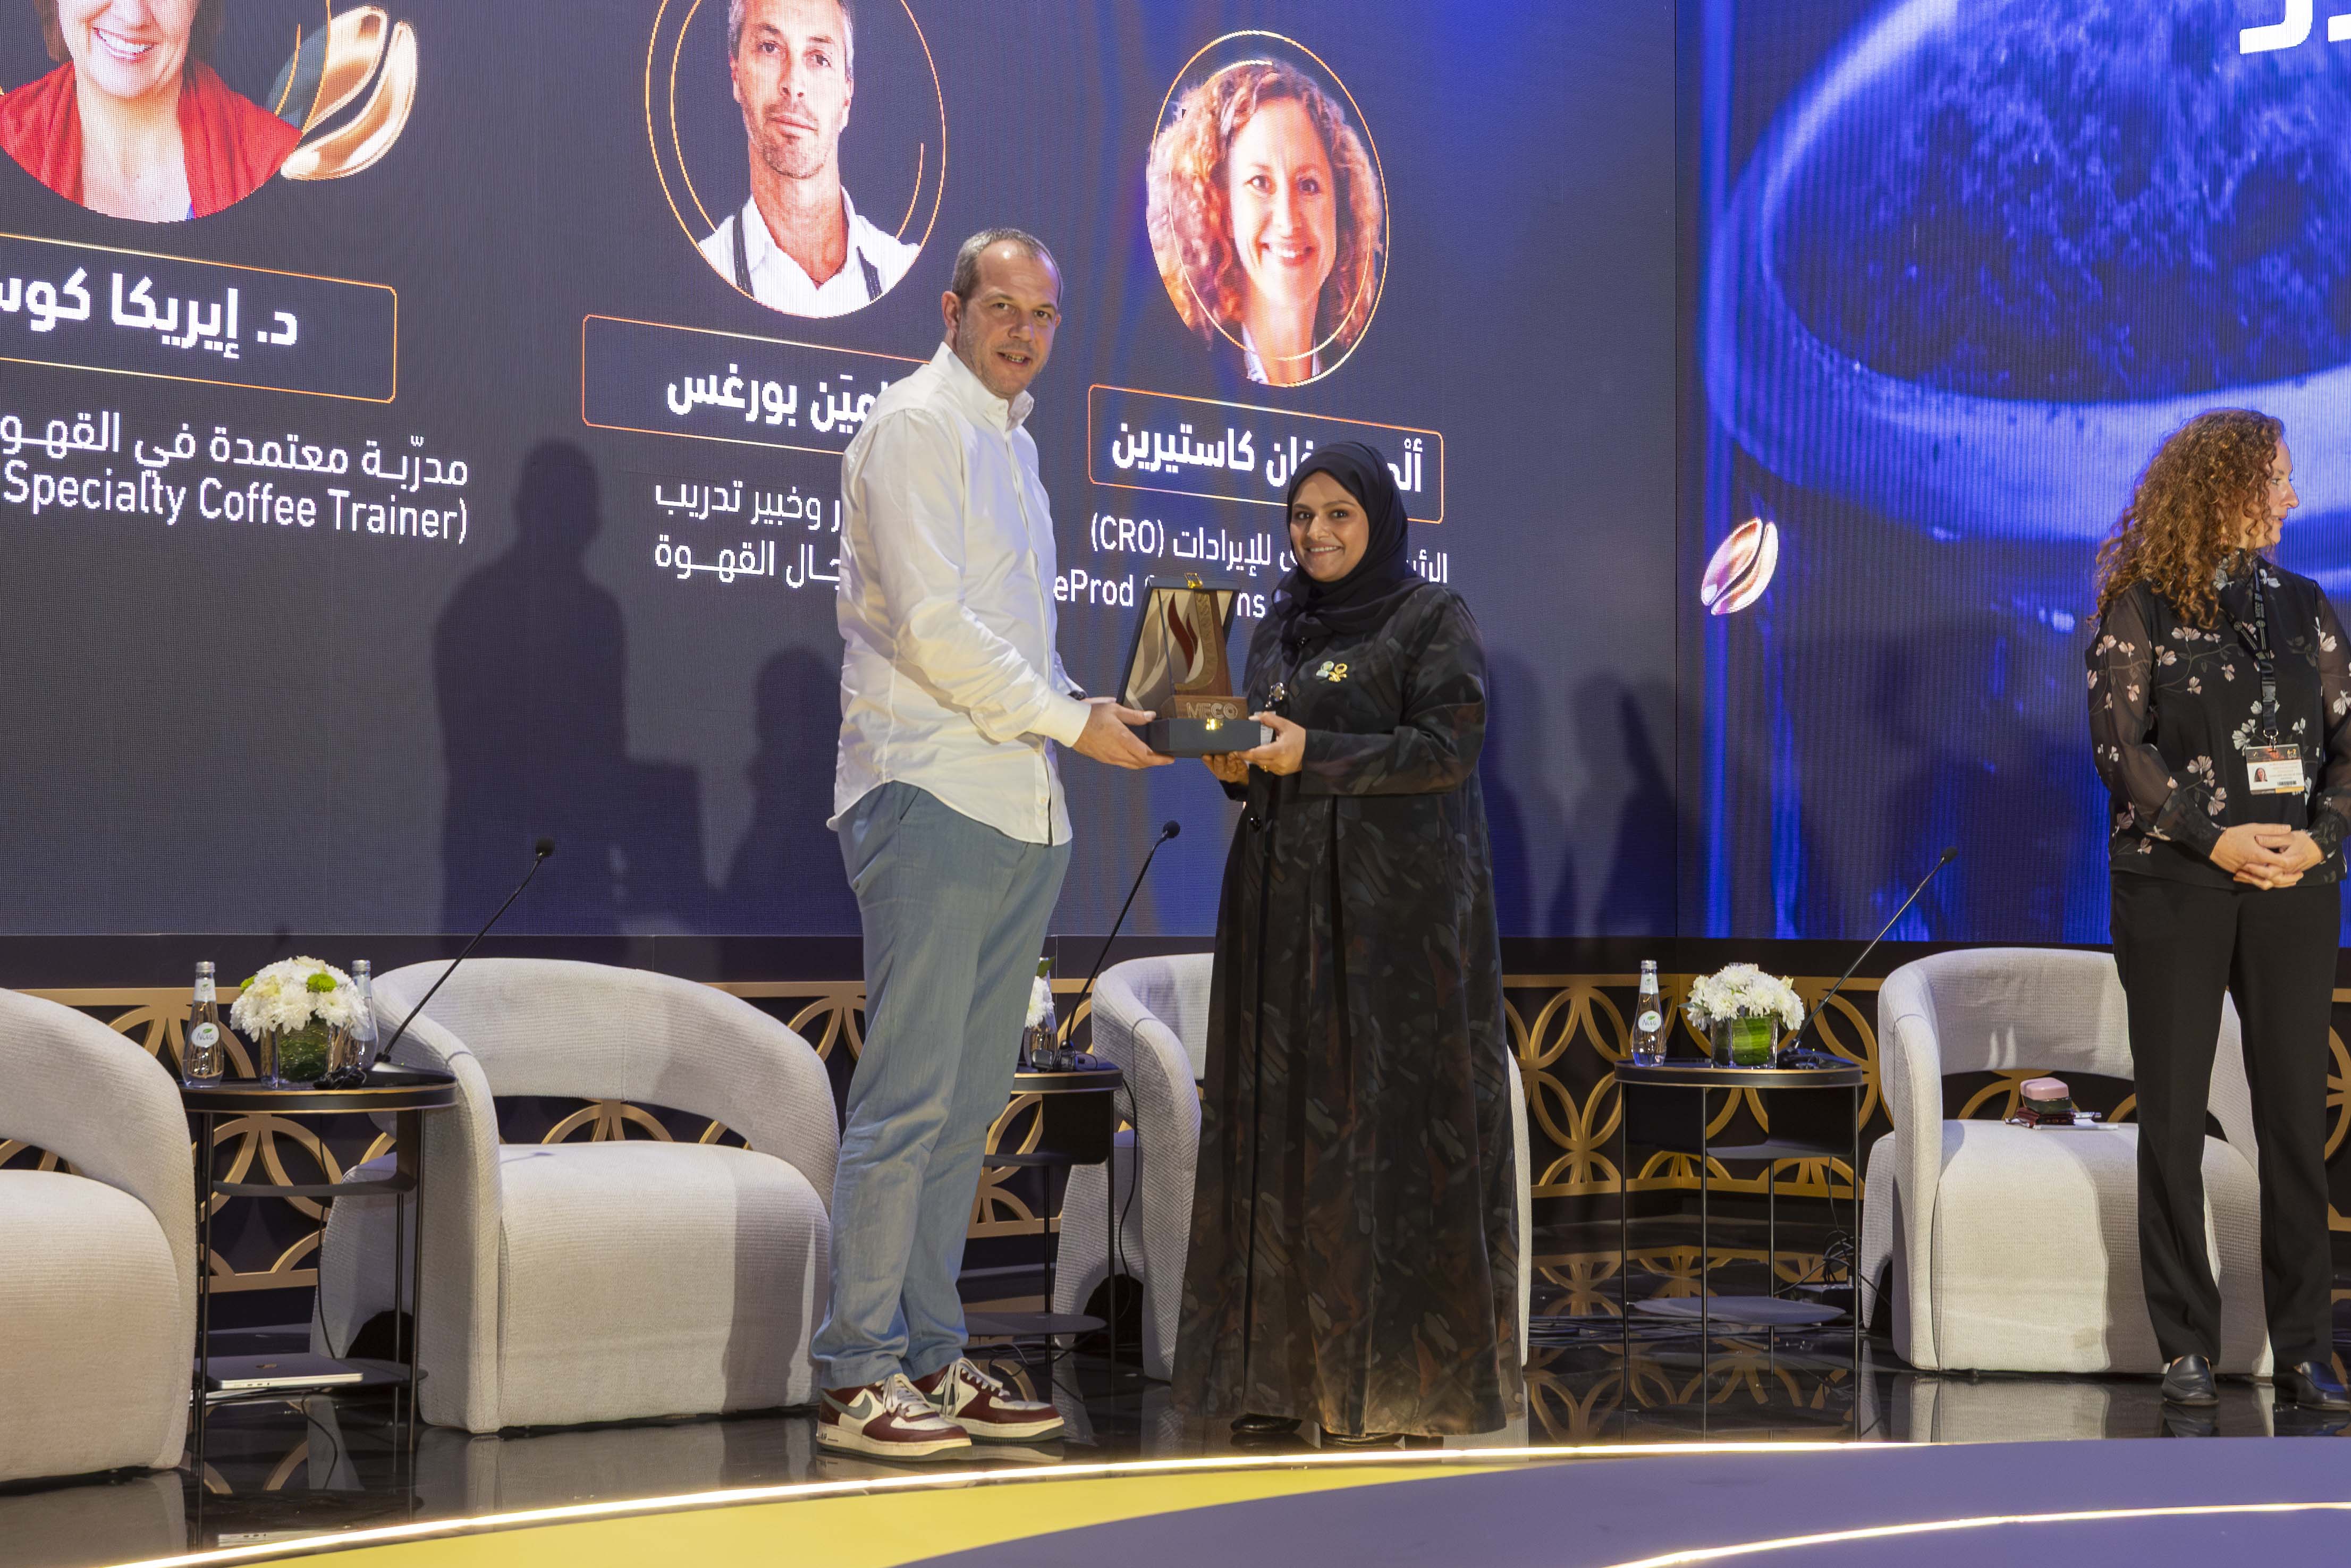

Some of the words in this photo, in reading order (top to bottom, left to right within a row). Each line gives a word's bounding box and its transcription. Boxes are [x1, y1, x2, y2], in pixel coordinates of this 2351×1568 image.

[112, 273, 239, 359] إيريكا
[258, 311, 297, 345] د.
[667, 363, 797, 427] بورغس
[135, 423, 196, 477] في
[210, 427, 348, 473] معتمدة
[361, 436, 467, 492] مدرّبة
[1112, 423, 1255, 473] كاستيرين
[4, 459, 187, 525] Specialty
[200, 477, 316, 527] Coffee
[328, 488, 467, 544] Trainer)
[656, 480, 742, 520] تدريب
[751, 487, 821, 530] وخبير
[1092, 512, 1164, 557] (CRO)
[1173, 527, 1270, 576] للإيرادات
[655, 535, 774, 583] القهوة
[787, 544, 840, 590] جال
[1053, 569, 1133, 606] eProd
